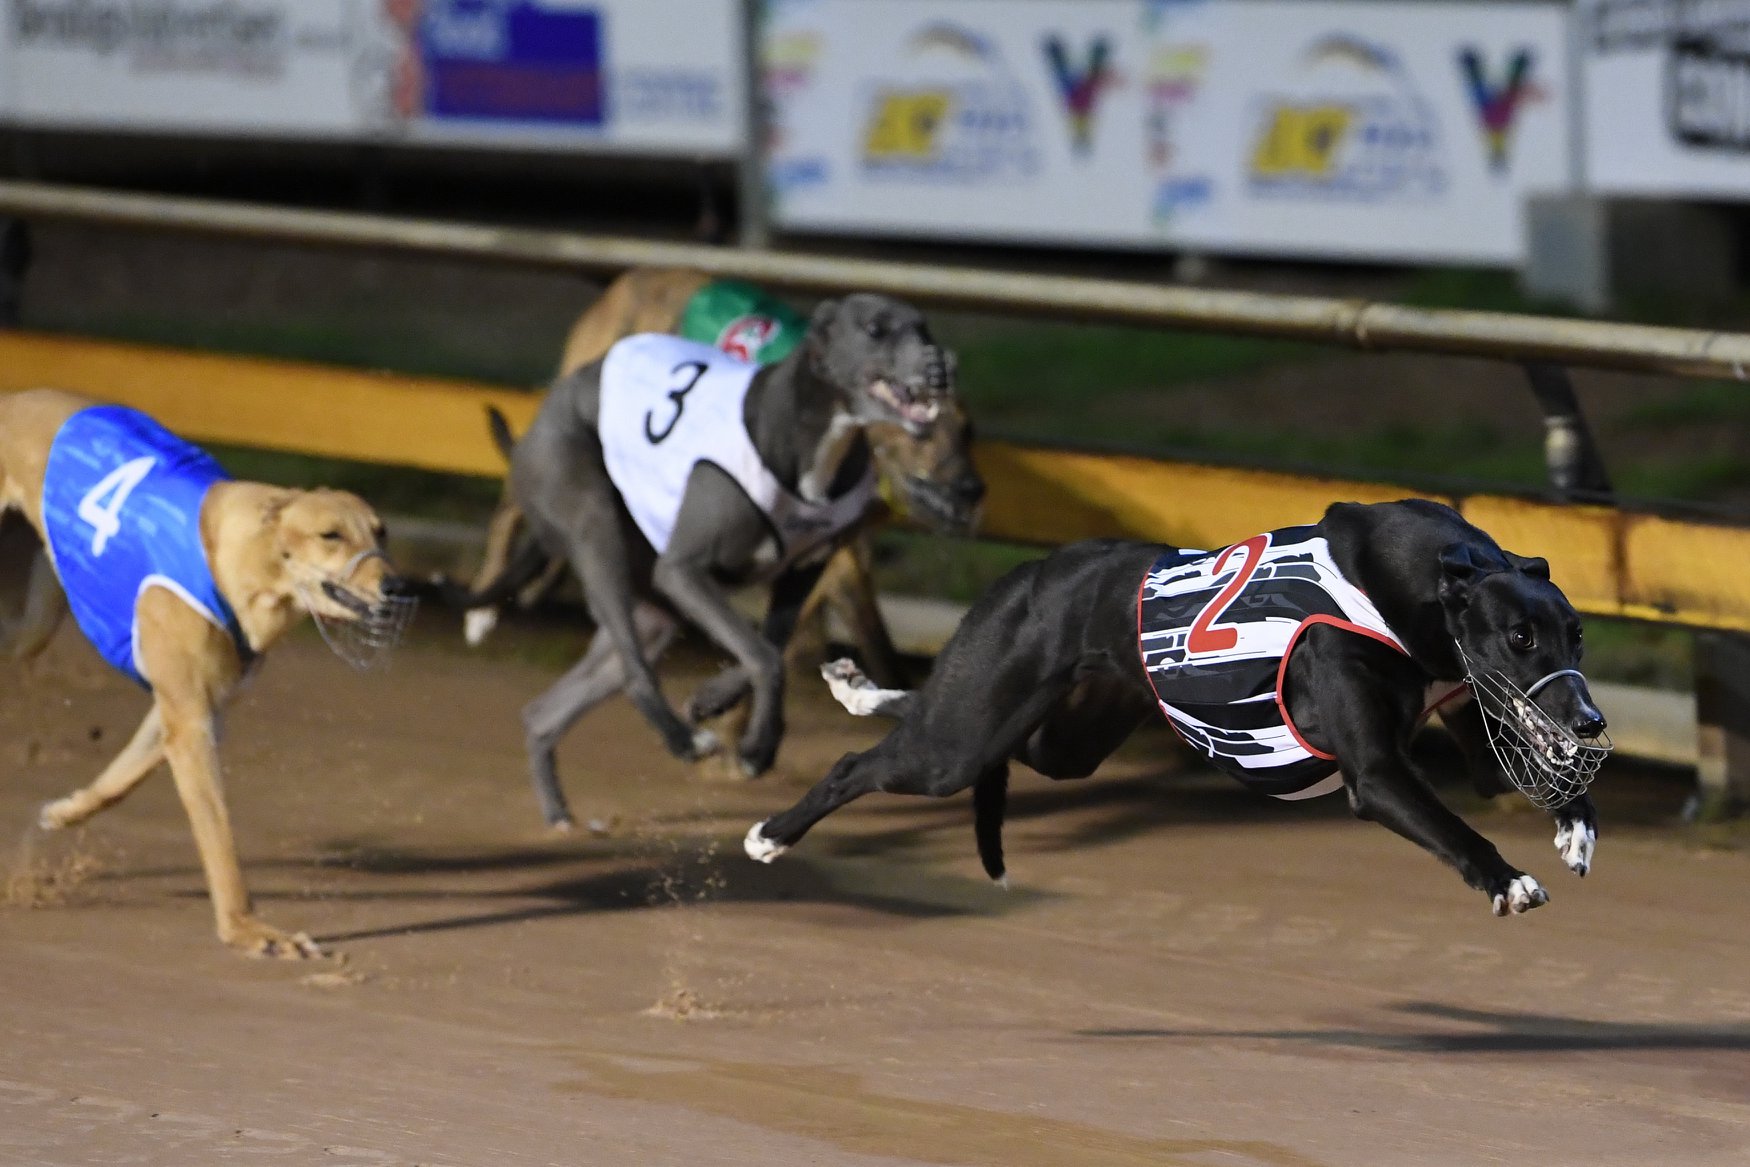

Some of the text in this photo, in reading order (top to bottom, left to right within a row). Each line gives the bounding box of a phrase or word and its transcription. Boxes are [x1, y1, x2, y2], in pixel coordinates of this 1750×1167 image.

[645, 360, 709, 445] 3
[77, 455, 156, 557] 4
[1186, 533, 1272, 655] 2
